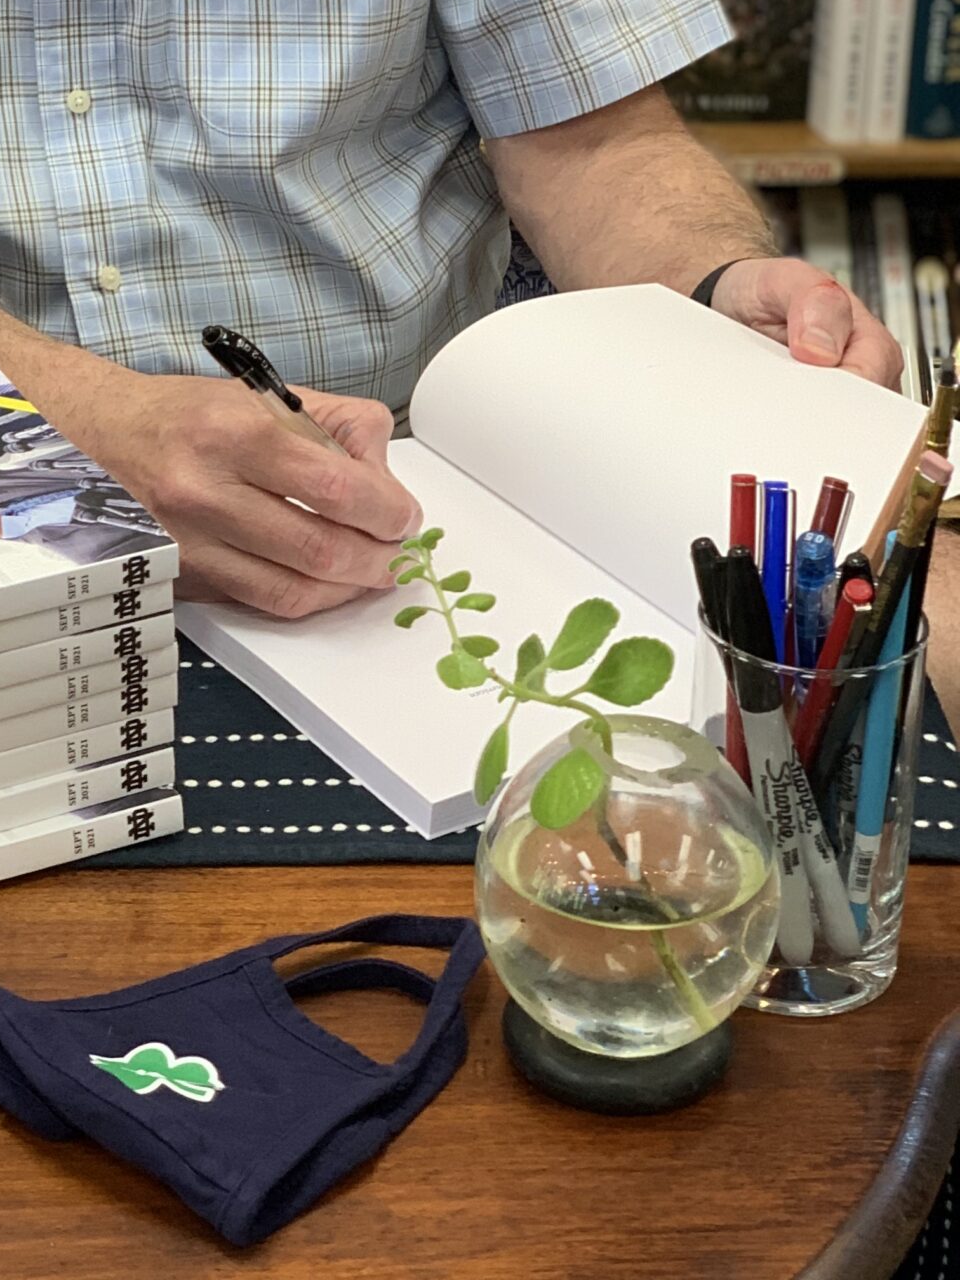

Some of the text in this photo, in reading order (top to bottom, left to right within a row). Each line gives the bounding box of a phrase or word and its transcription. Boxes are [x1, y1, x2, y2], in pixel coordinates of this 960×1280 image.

[67, 576, 76, 600] SEPT
[81, 574, 89, 594] 2021
[58, 607, 67, 631] SEPT
[72, 605, 81, 626] 2021
[59, 647, 68, 670] SEPT
[73, 645, 81, 665] 2021
[68, 676, 76, 700] SEPT
[81, 674, 89, 694] 2021
[67, 705, 76, 729] SEPT
[80, 703, 89, 723] 2021
[67, 740, 76, 764] SEPT
[80, 738, 89, 759] 2021
[67, 783, 76, 806] SEPT
[81, 780, 89, 800] 2021
[73, 830, 82, 854] SEPT
[87, 828, 95, 849] 2021
